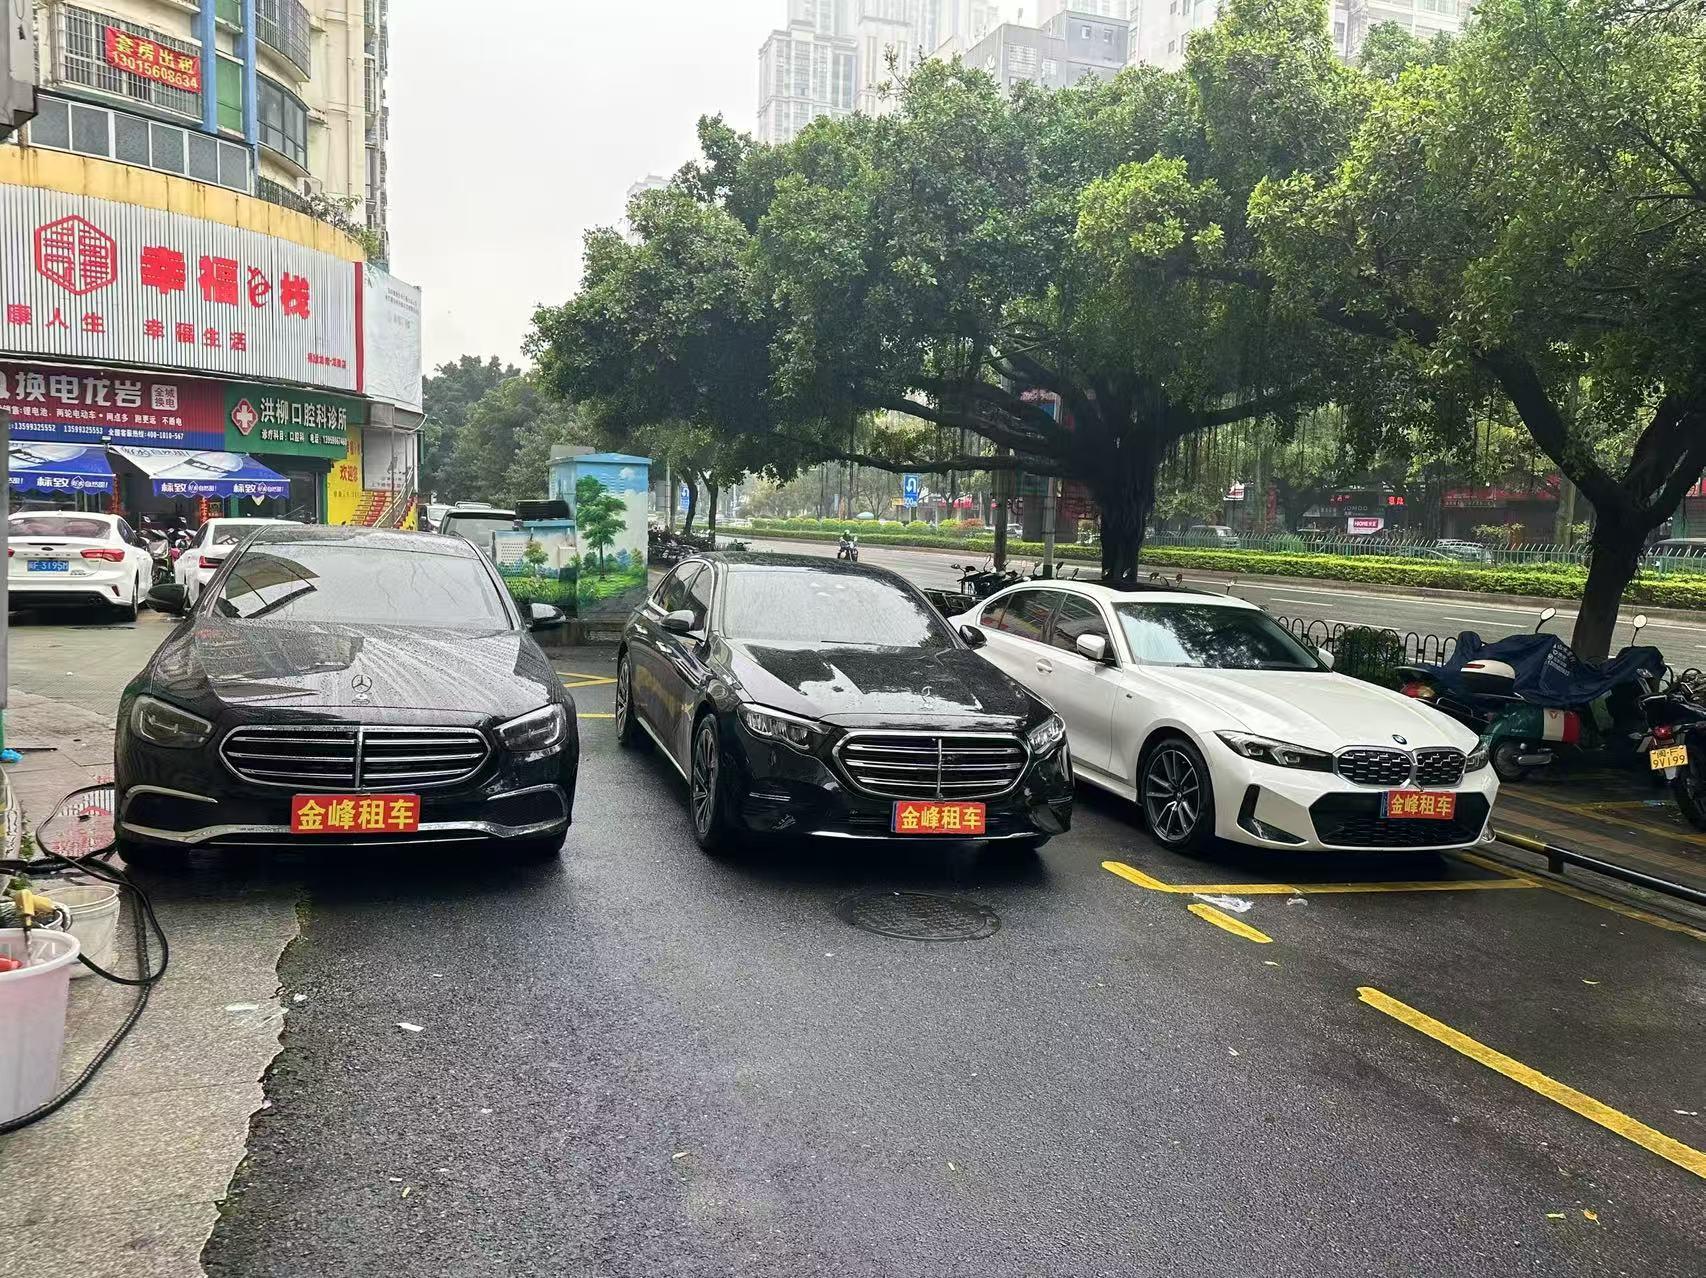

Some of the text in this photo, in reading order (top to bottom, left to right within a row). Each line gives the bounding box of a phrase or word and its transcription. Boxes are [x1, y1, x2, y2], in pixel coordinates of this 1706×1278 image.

[115, 34, 194, 74] 套房出租
[113, 51, 198, 89] 13015608634
[143, 318, 247, 352] 幸福生活
[56, 408, 97, 419] 两轮电动车
[260, 397, 347, 431] 洪柳口腔科诊所
[1652, 754, 1686, 768] 9V199
[297, 799, 415, 830] 金峰租车
[900, 805, 982, 830] 金峰租车
[1390, 794, 1453, 816] 金峰租车
